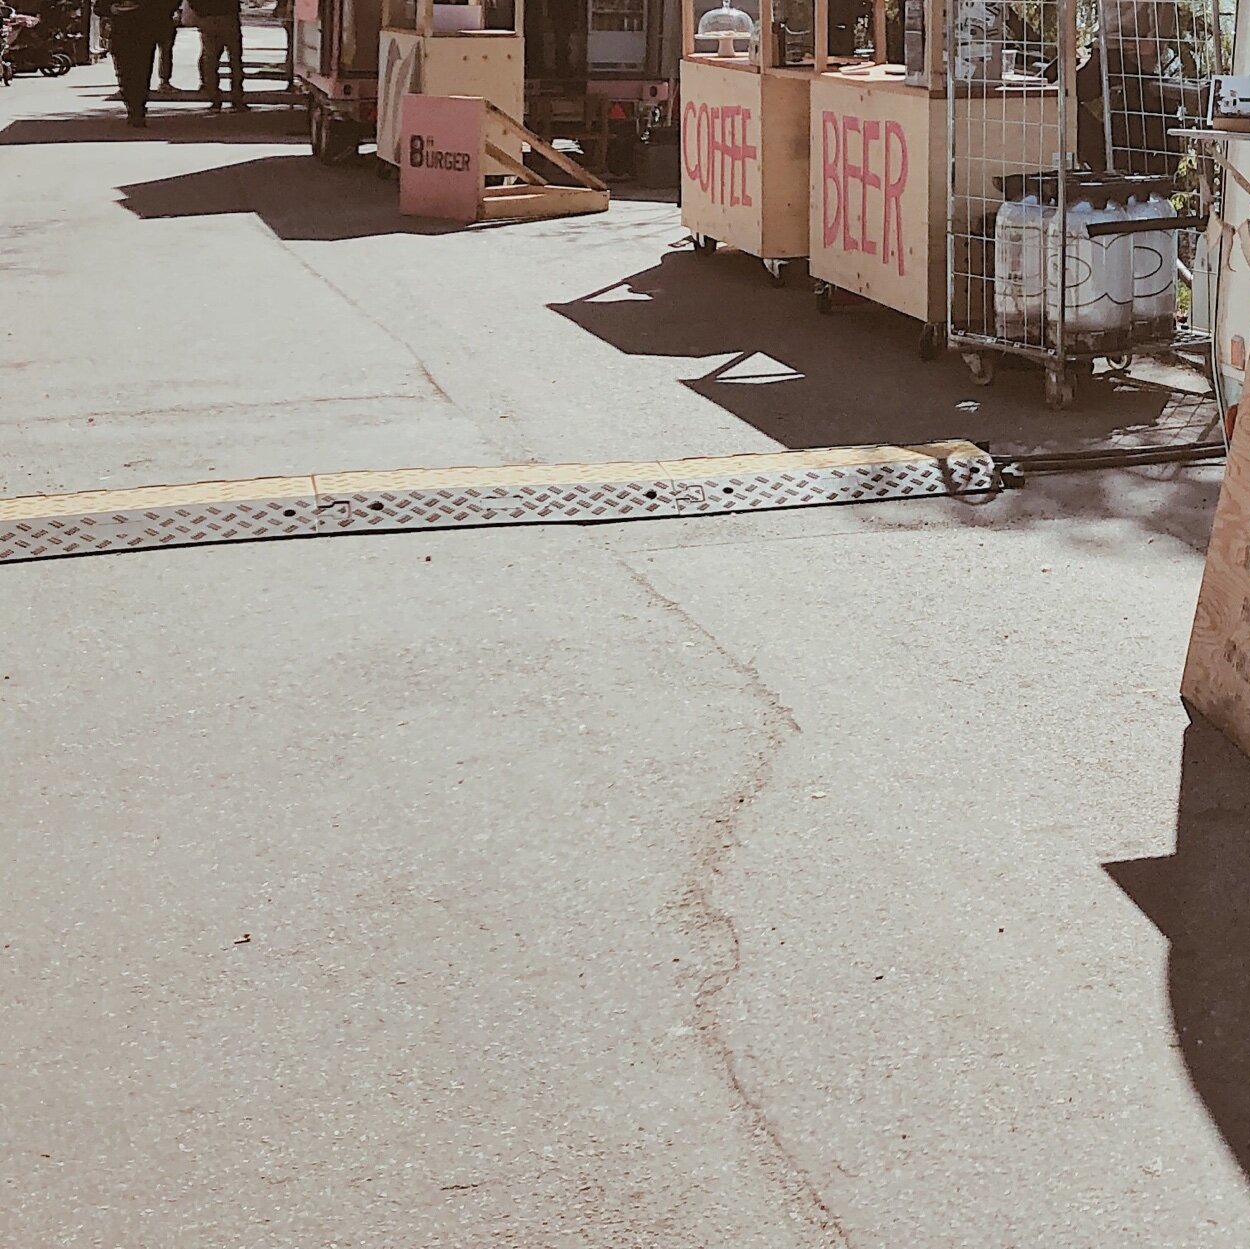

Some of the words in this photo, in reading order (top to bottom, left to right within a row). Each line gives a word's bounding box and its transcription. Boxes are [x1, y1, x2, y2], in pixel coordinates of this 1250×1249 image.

[409, 134, 471, 172] BURGER
[682, 100, 757, 208] COFFEE
[821, 110, 908, 277] BEER
